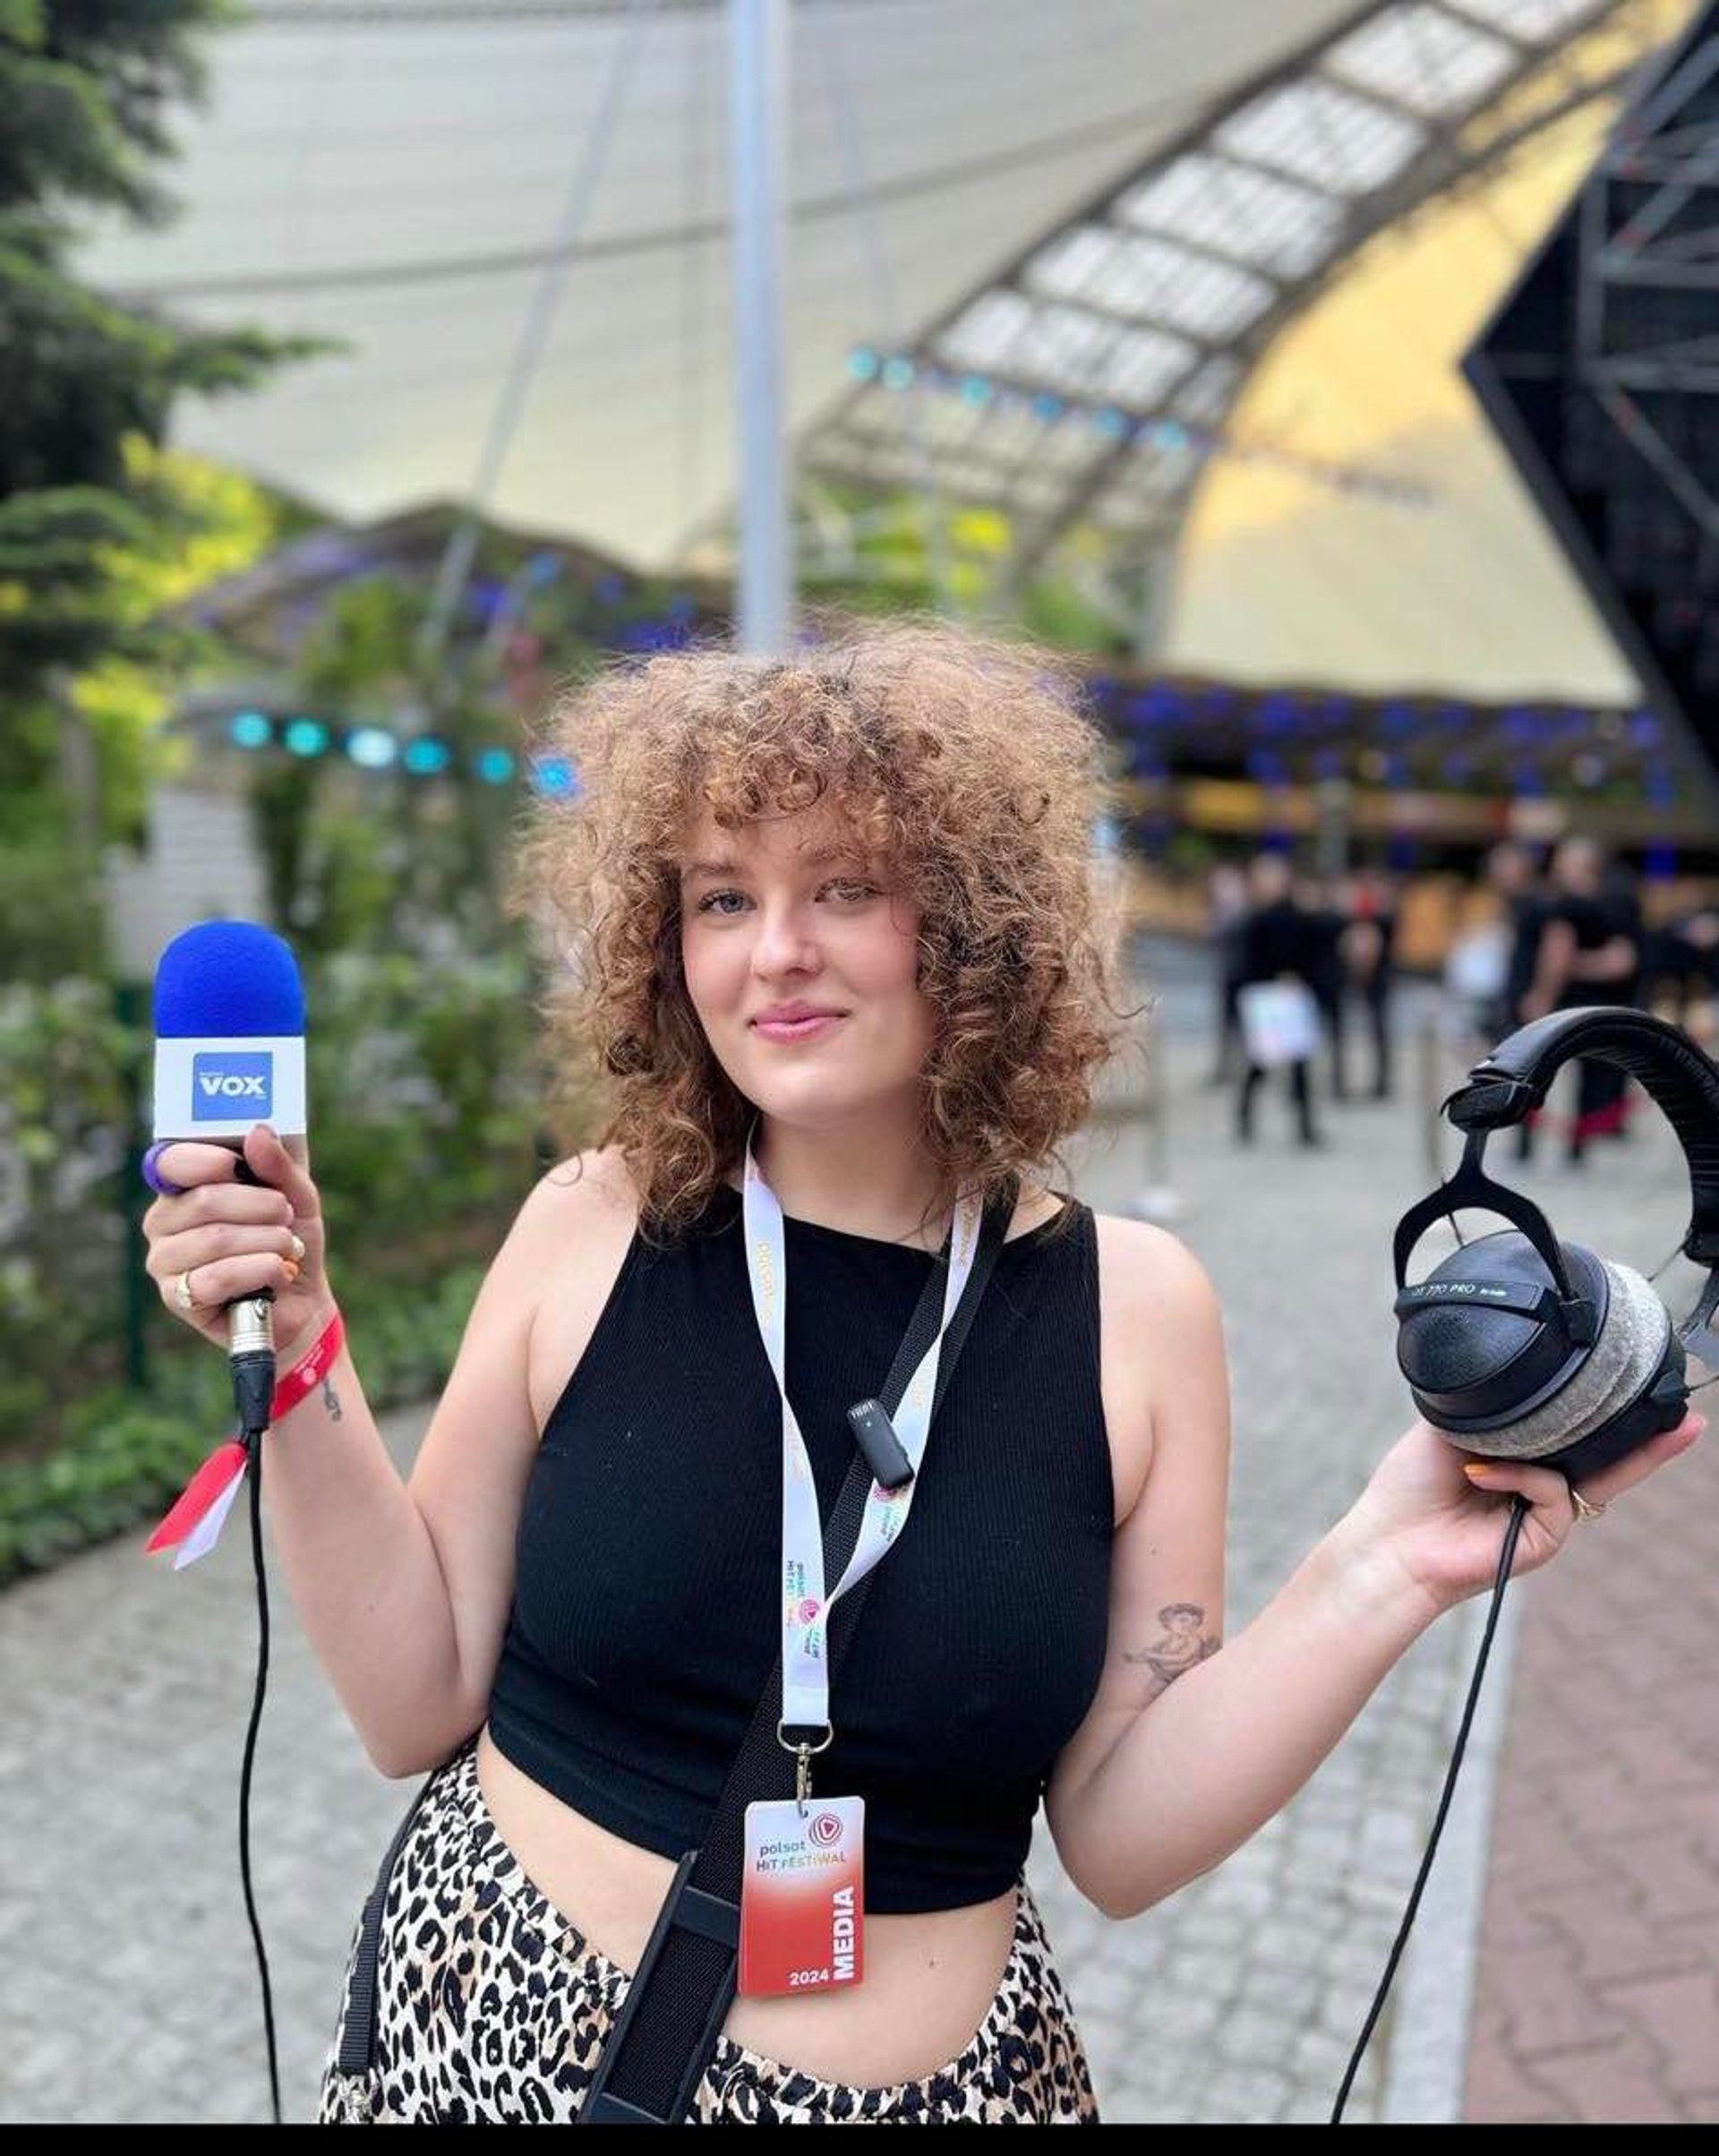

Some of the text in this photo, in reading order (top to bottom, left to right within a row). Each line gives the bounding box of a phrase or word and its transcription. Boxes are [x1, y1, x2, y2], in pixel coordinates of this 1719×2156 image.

[200, 1076, 266, 1097] VOX
[1450, 1283, 1475, 1295] PRO
[760, 1840, 806, 1858] polsat
[833, 1886, 854, 1981] MEDIA
[789, 1969, 830, 1986] 2024
